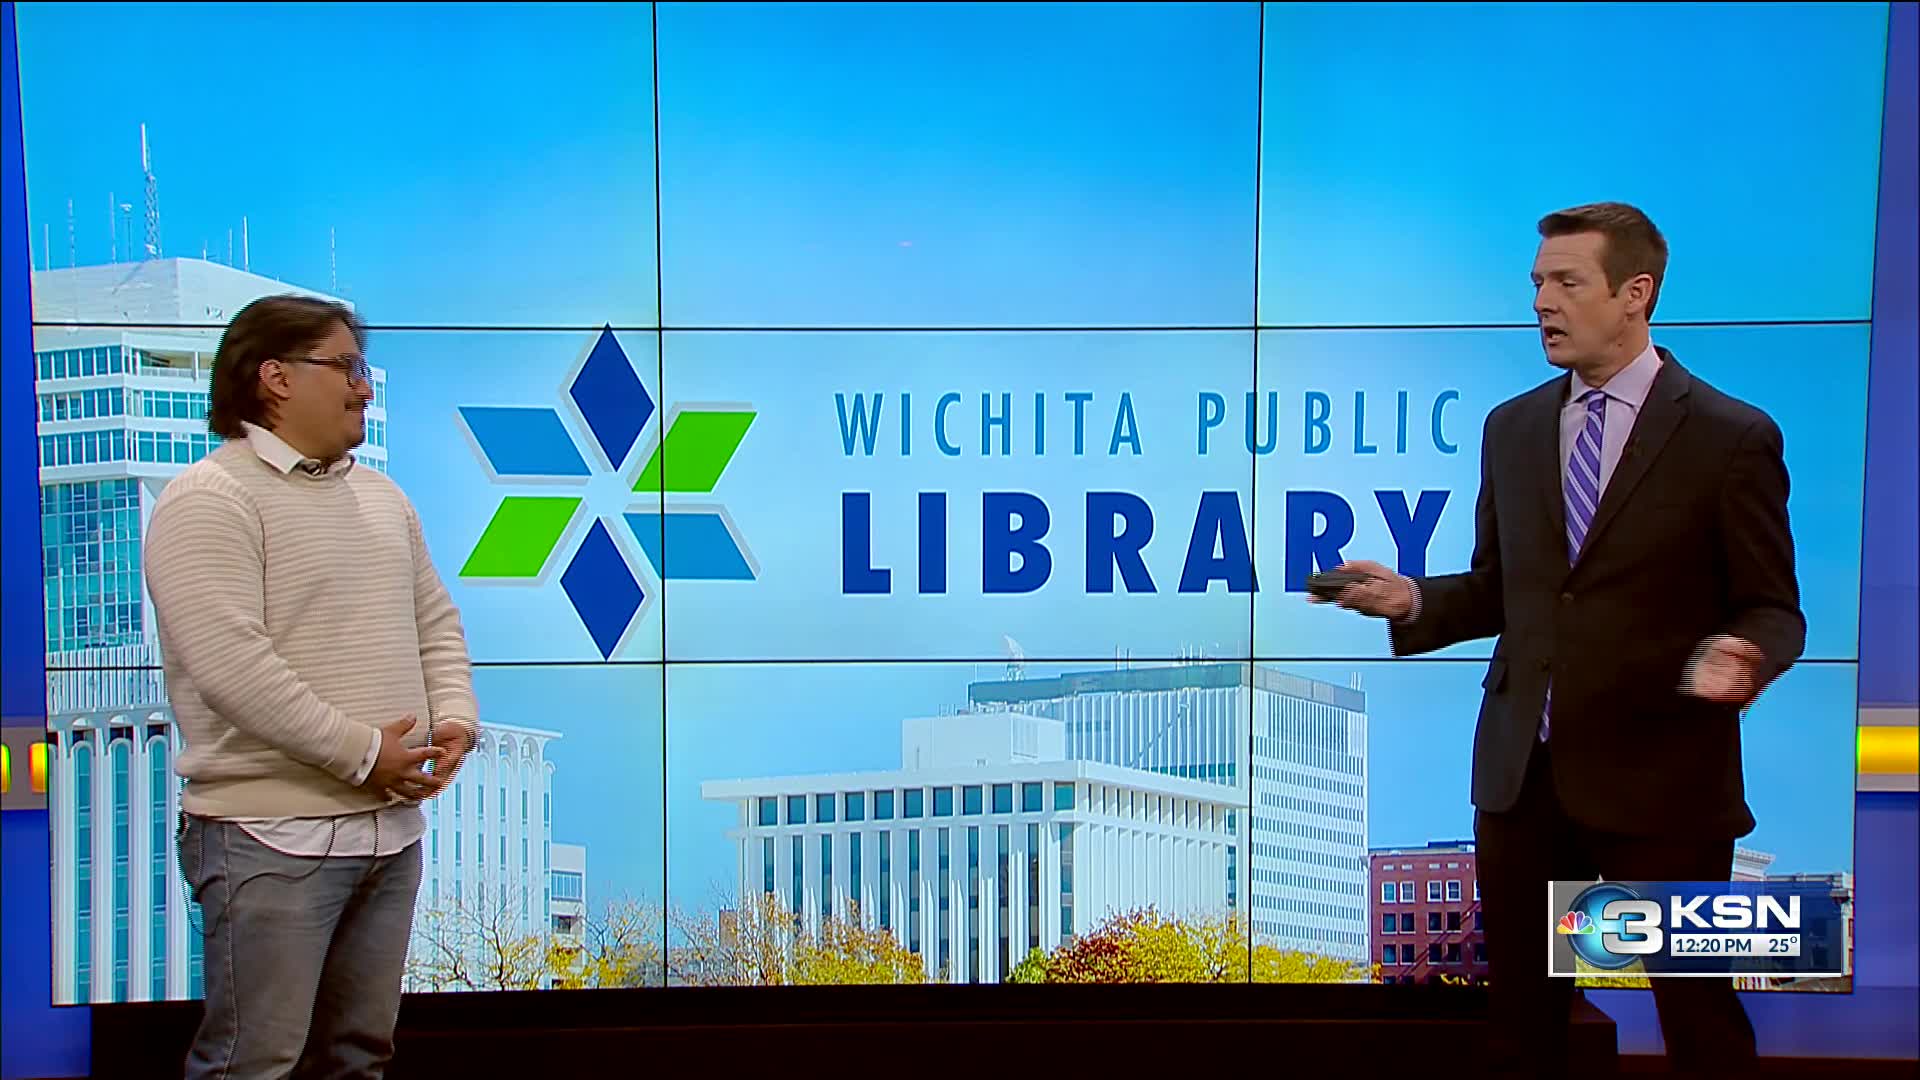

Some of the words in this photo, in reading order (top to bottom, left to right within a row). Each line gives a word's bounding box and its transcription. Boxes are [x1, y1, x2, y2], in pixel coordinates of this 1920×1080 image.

[835, 392, 1142, 456] WICHITA
[1198, 391, 1460, 455] PUBLIC
[841, 490, 1452, 594] LIBRARY
